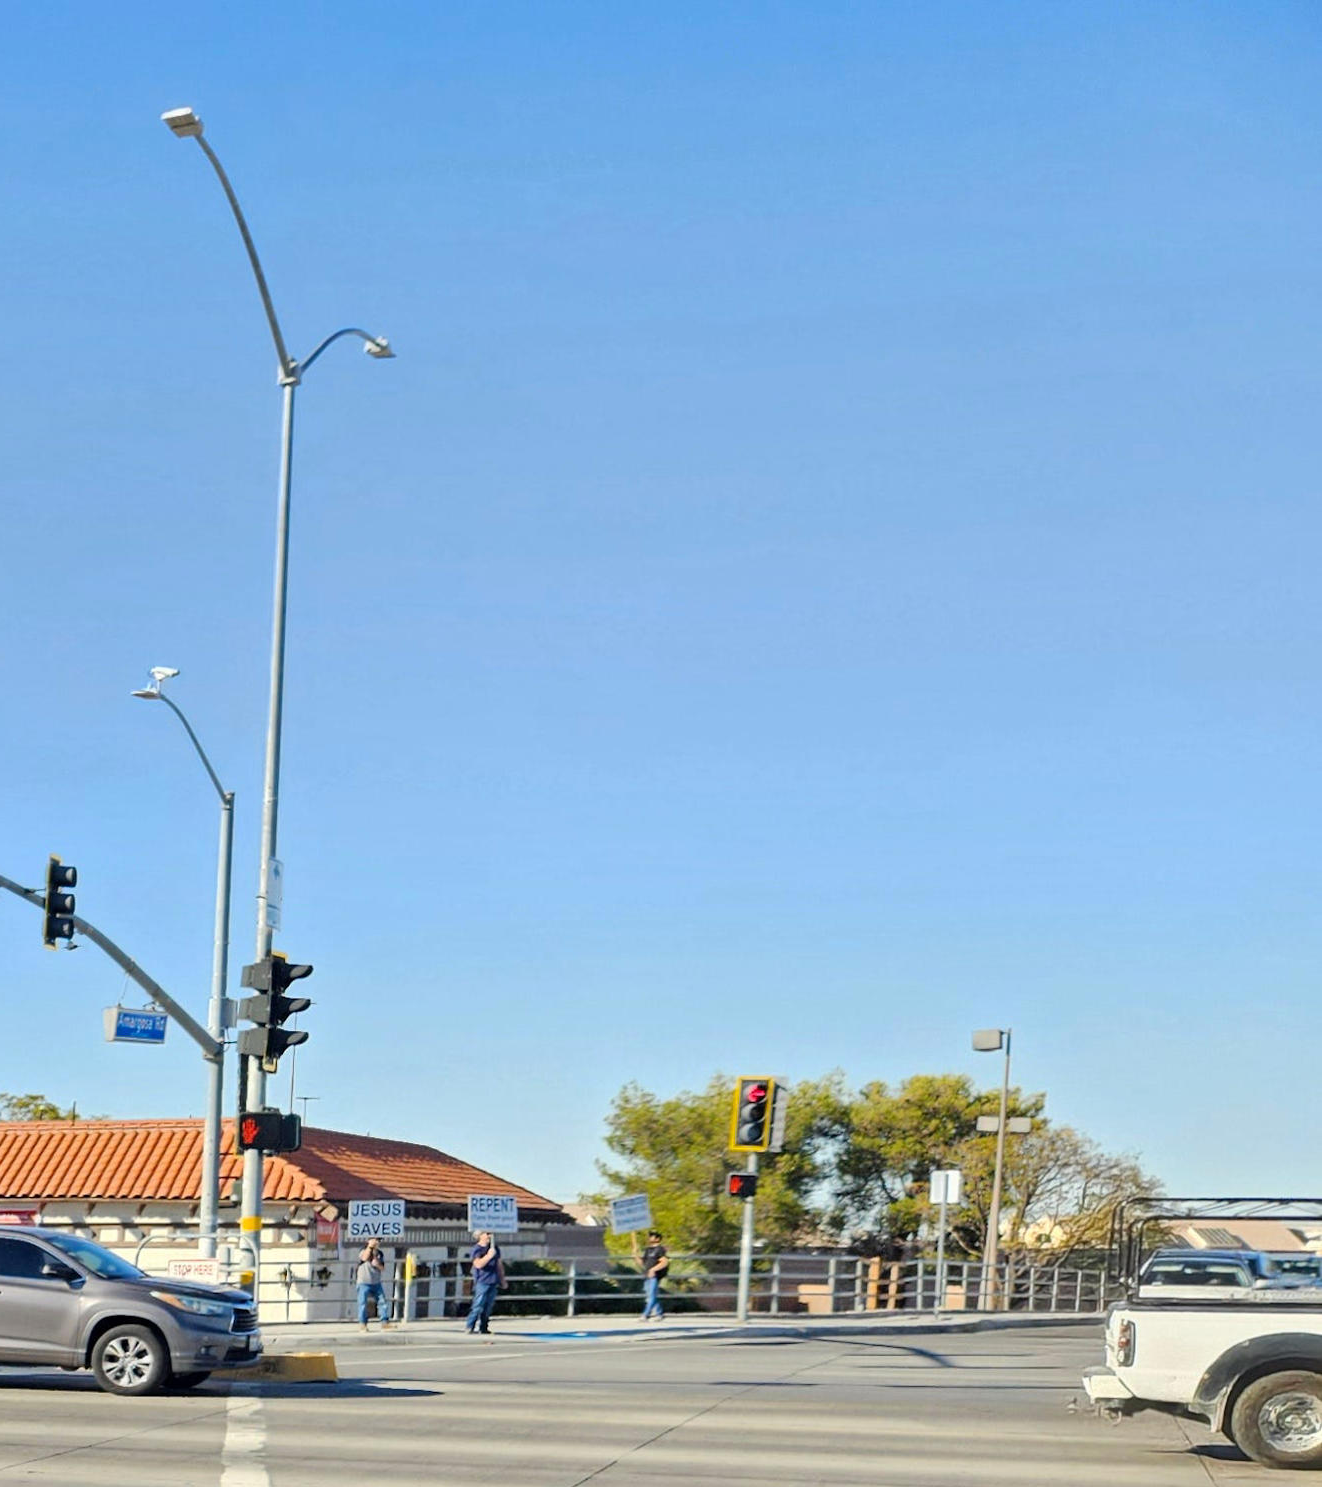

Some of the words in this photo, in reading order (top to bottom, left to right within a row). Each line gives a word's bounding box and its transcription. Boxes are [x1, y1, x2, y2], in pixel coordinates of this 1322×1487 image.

[350, 1203, 402, 1218] JESUS
[471, 1197, 515, 1212] REPENT
[350, 1221, 402, 1237] SAVES
[173, 1264, 192, 1276] STOP
[193, 1264, 214, 1276] HERE
